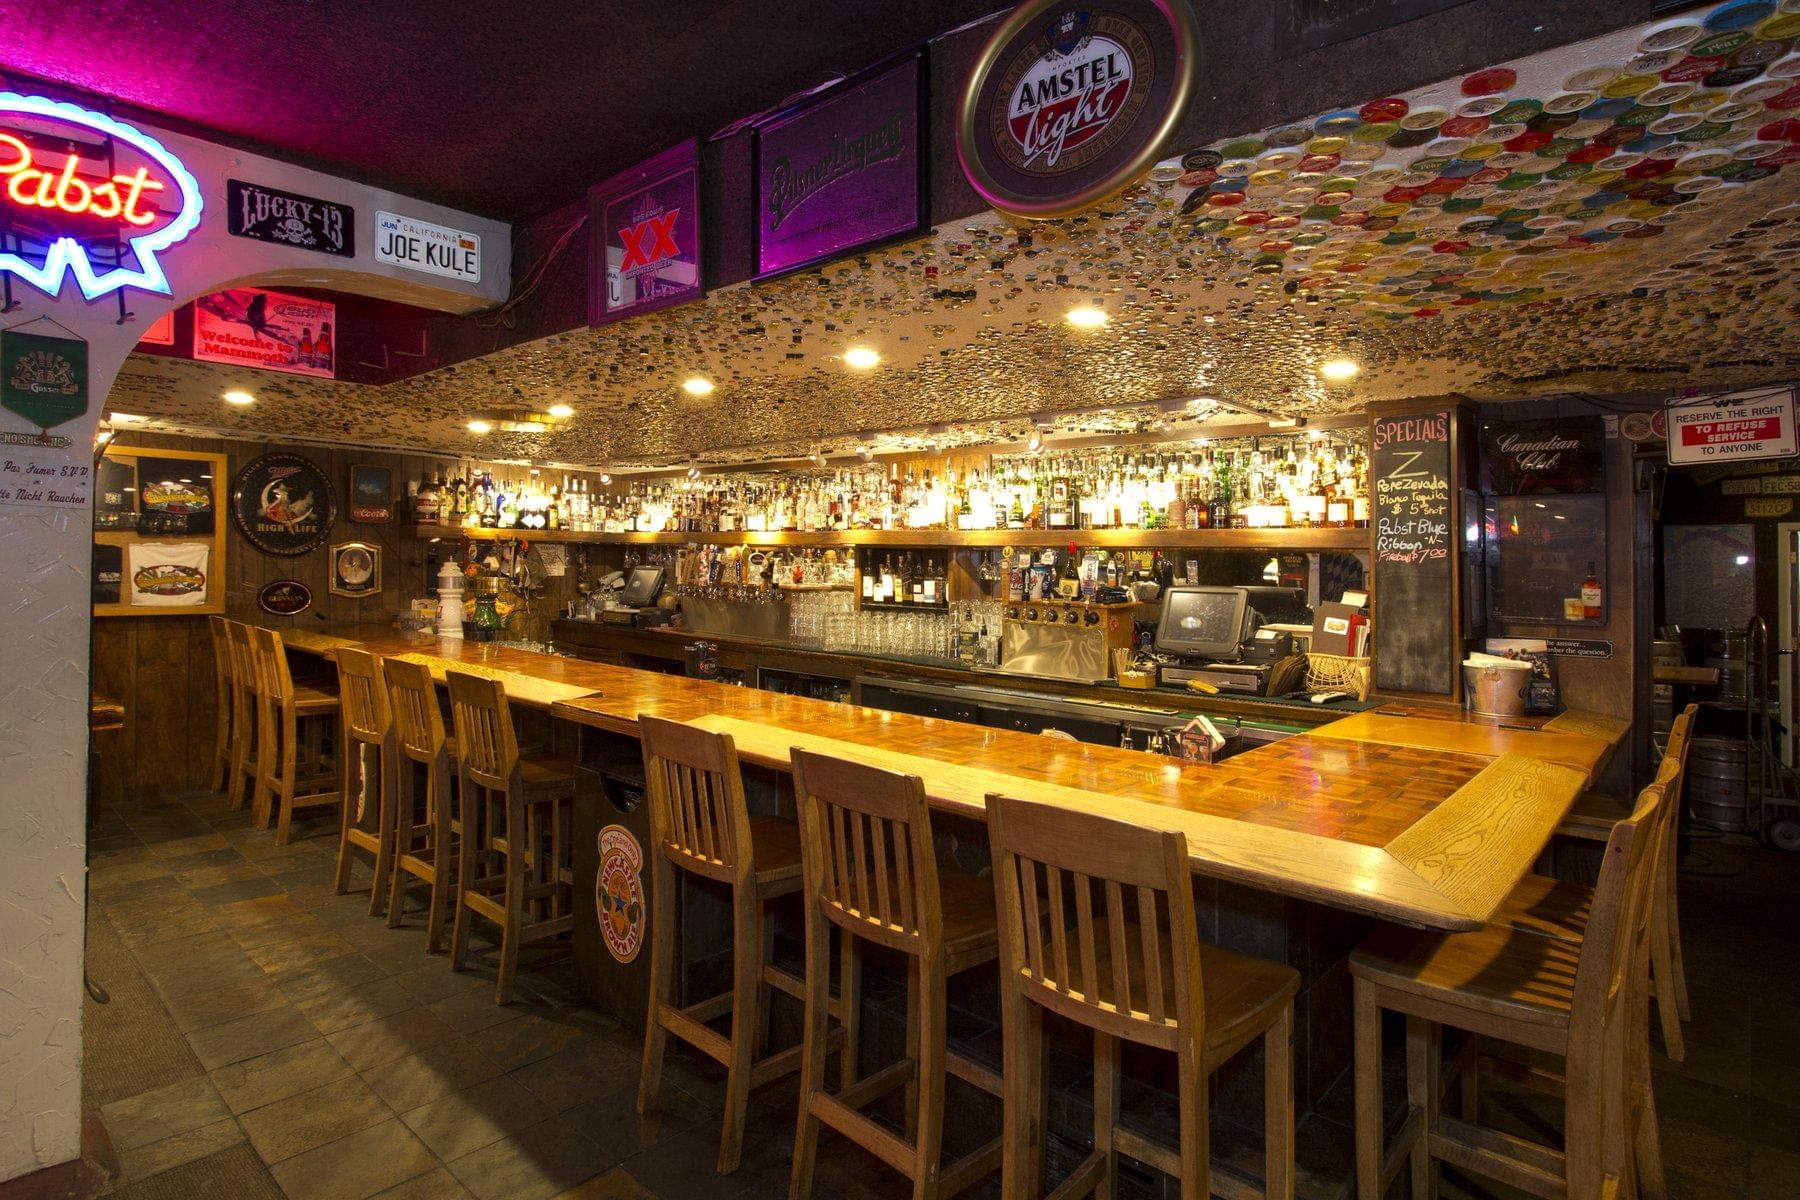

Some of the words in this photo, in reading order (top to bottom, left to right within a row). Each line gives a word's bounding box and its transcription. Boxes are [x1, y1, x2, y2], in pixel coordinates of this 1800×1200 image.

[1049, 55, 1086, 72] IMPORTED
[1018, 53, 1122, 111] AMSTEL
[240, 188, 343, 250] LUCKY-13
[633, 214, 645, 223] DOS
[645, 206, 664, 218] EQUIS
[380, 220, 398, 231] JUN
[402, 223, 457, 243] CALIFORNIA
[618, 207, 681, 272] XX
[381, 233, 420, 263] JOE
[425, 242, 477, 275] KULE
[200, 330, 274, 351] Welcome
[277, 341, 294, 353] to
[204, 343, 290, 364] Mammoth
[1713, 398, 1745, 408] WE
[1676, 411, 1723, 424] RESERVE
[1727, 409, 1747, 419] THE
[1752, 405, 1785, 417] RIGHT
[1375, 418, 1446, 445] SPECIALS
[1695, 425, 1712, 434] TO
[1716, 419, 1767, 432] REFUSE
[4, 432, 18, 443] NO
[20, 435, 65, 447] SMONG
[1497, 432, 1582, 453] Canadian
[1707, 430, 1756, 443] SERVICE
[1701, 446, 1715, 455] TO
[1719, 442, 1763, 454] ANYONE
[3, 460, 21, 473] Pas
[25, 461, 56, 477] Fumer
[15, 488, 43, 501] Nicht
[47, 490, 86, 504] Rauchen
[1379, 494, 1409, 506] Blanco
[1411, 489, 1448, 505] Tequila
[1377, 517, 1417, 539] Pabst
[1417, 518, 1449, 535] Blue
[1378, 536, 1423, 551] Ribbon
[1577, 649, 1607, 657] question.
[602, 856, 637, 898] NEWCASTLE
[603, 912, 628, 954] BROWN
[627, 925, 638, 950] ALE
